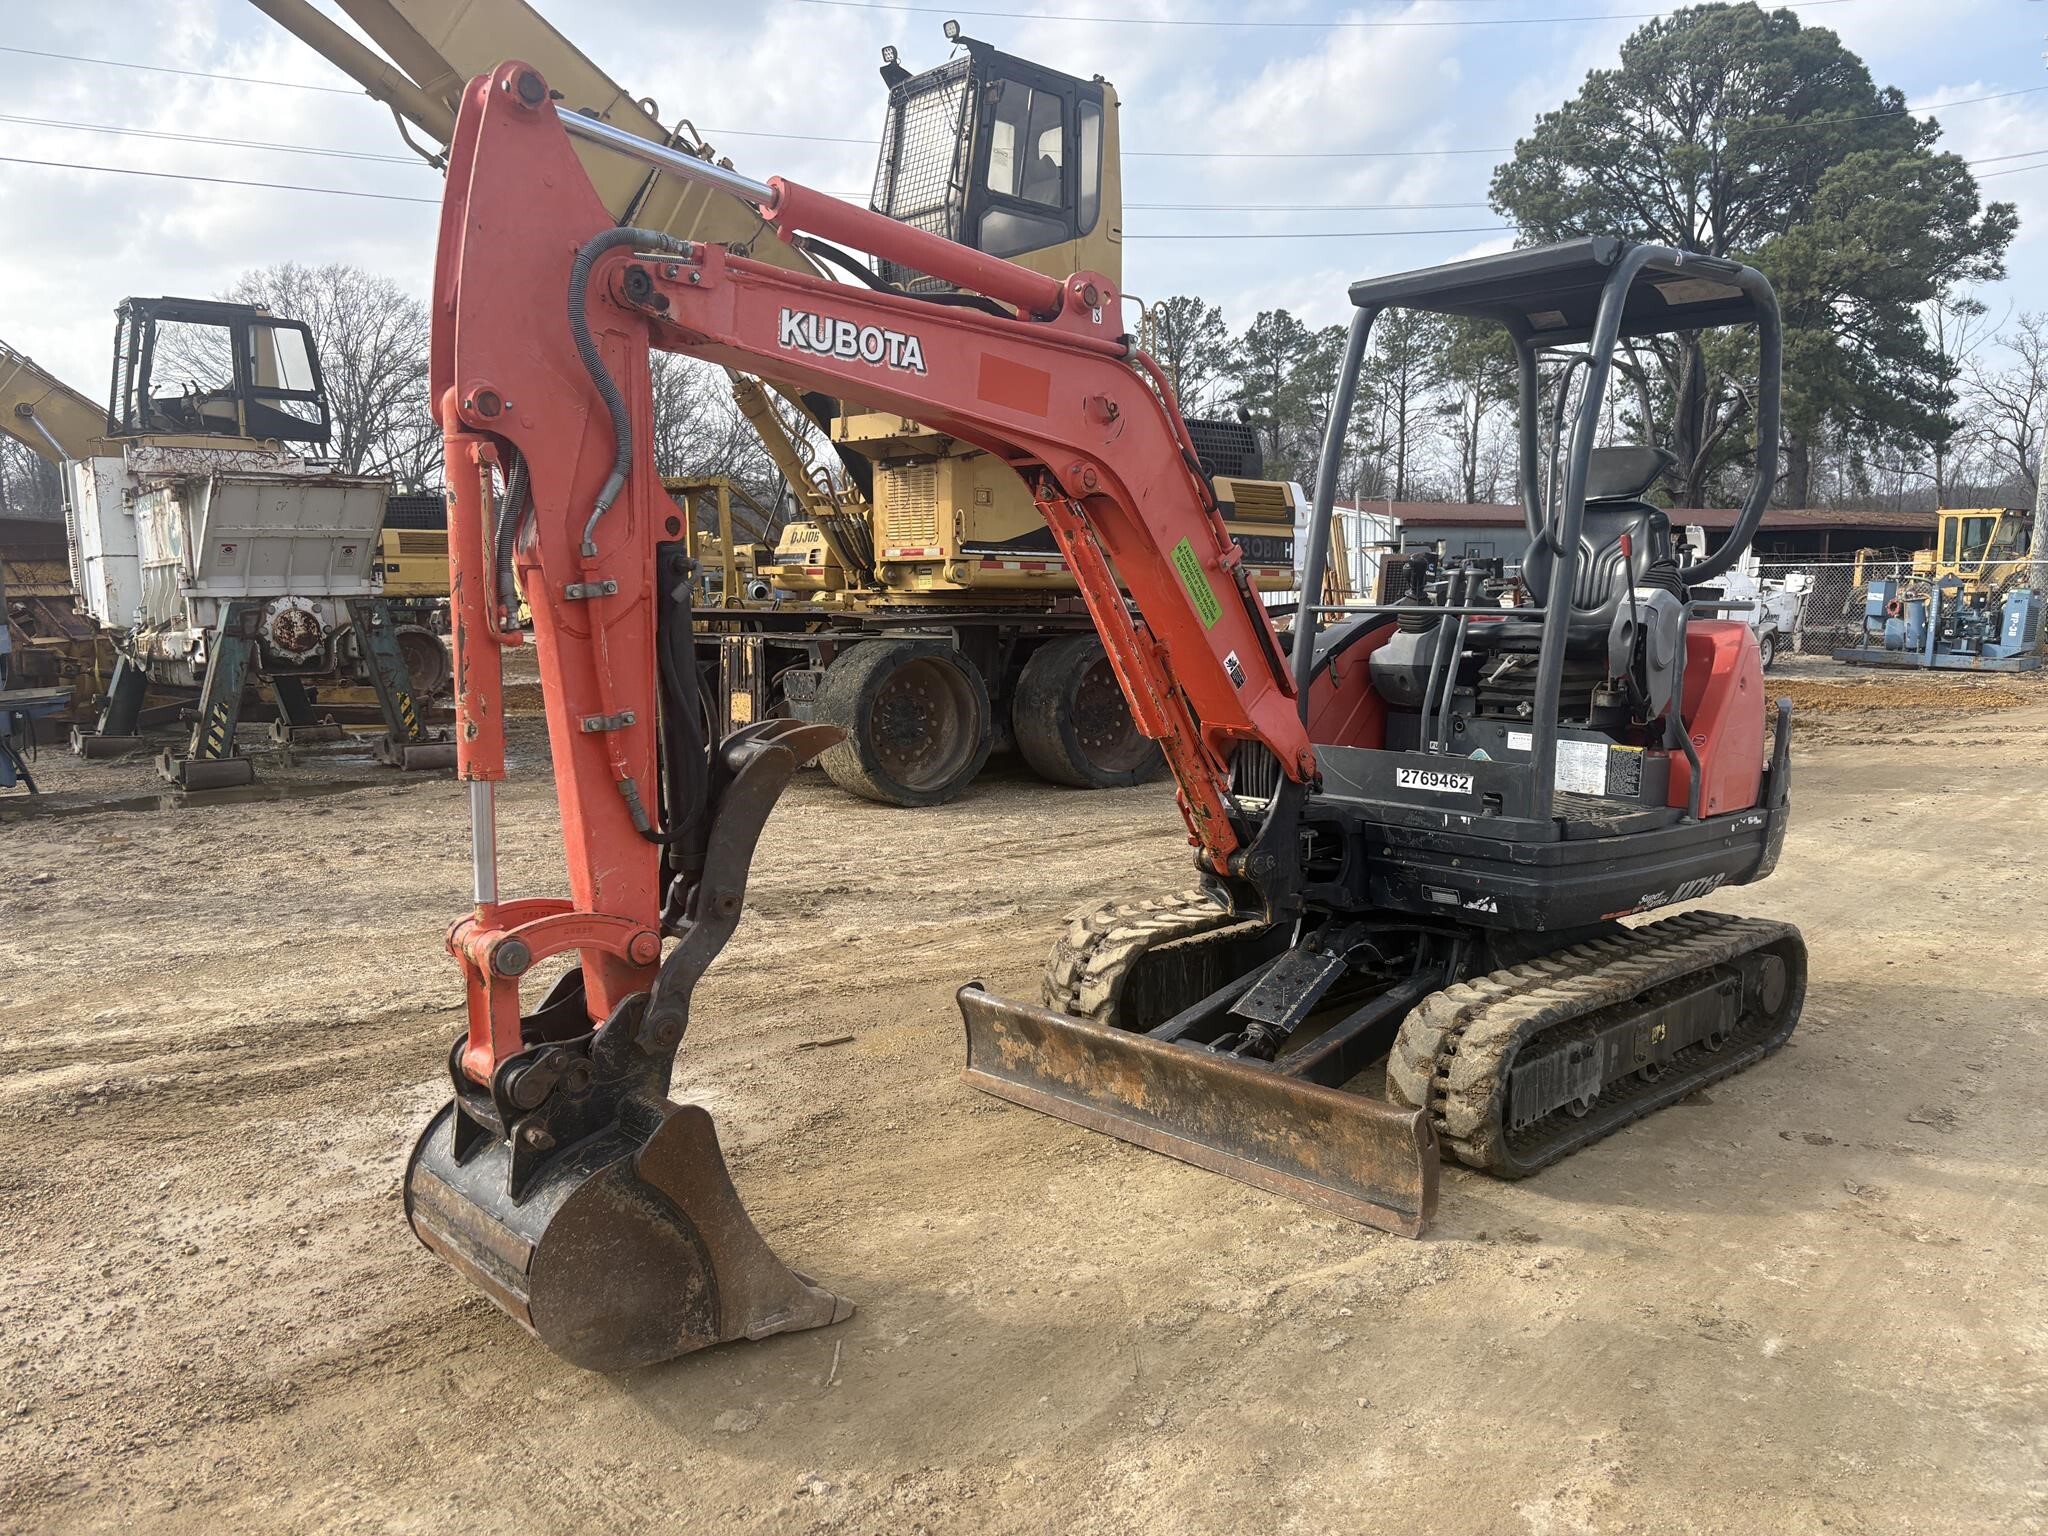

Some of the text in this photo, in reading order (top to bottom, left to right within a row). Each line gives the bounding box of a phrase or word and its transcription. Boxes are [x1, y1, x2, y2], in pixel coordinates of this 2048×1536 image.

[779, 307, 927, 375] KUBOTA
[1178, 561, 1187, 575] NOT
[1184, 572, 1201, 603] RETURNED
[1198, 600, 1210, 621] CLEAN
[1180, 552, 1196, 581] CHARGED
[1196, 584, 1205, 598] THIS
[1202, 595, 1216, 621] MACHINE
[1190, 561, 1206, 590] CLEANING
[1203, 587, 1211, 600] FEE
[1208, 597, 1217, 612] WILL
[1401, 769, 1469, 790] 2769462
